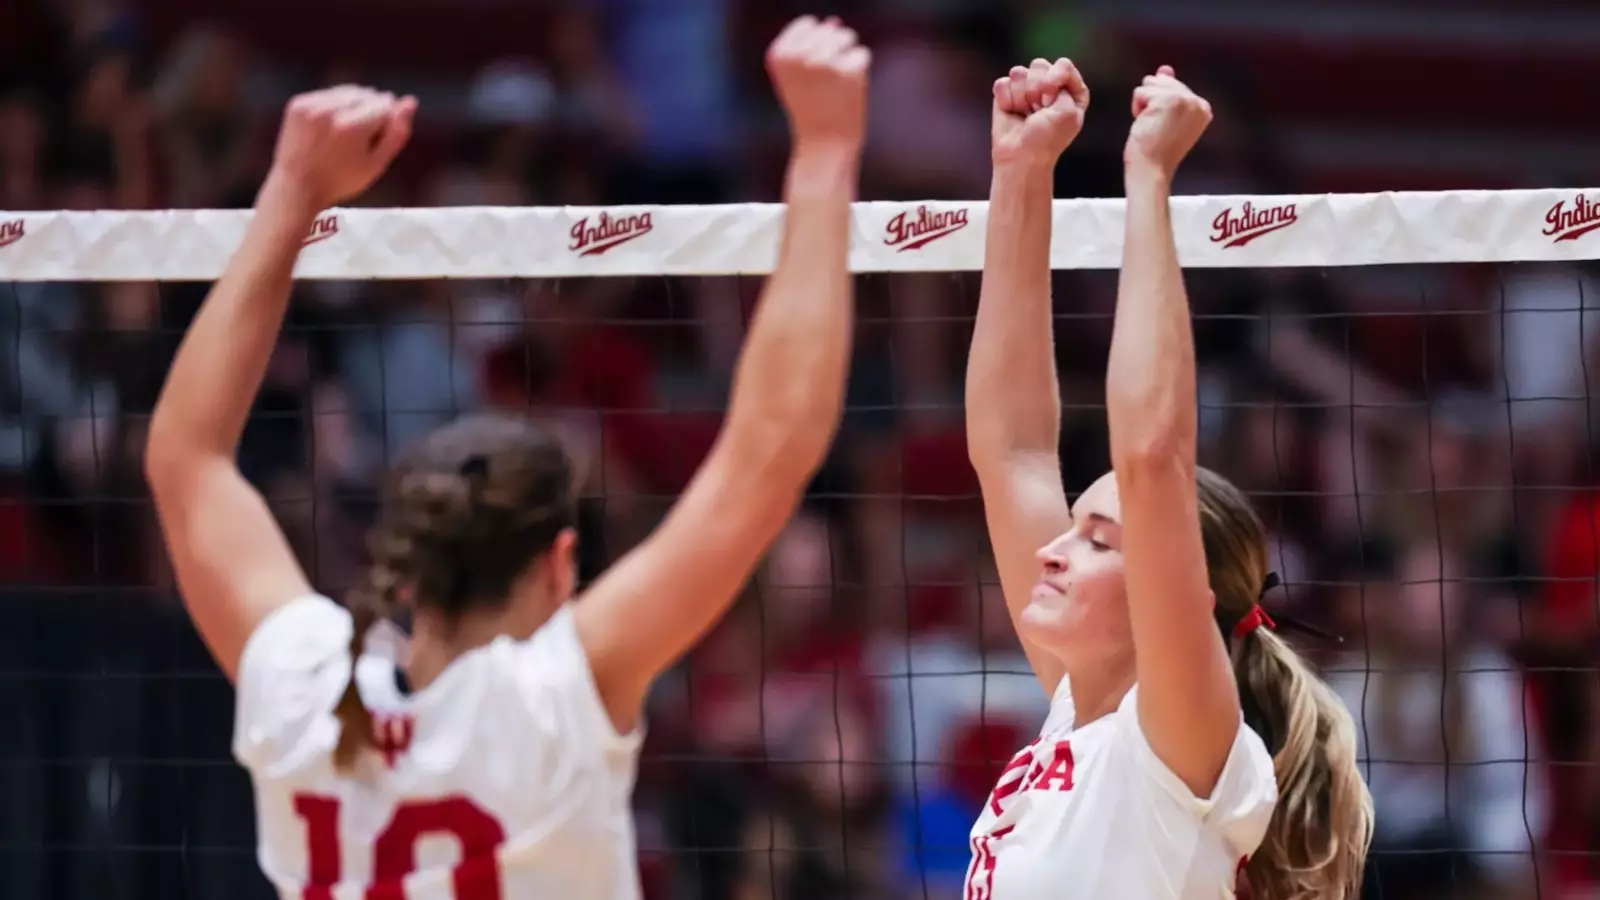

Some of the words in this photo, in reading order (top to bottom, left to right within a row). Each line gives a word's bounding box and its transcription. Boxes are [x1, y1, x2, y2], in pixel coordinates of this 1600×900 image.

[569, 211, 653, 253] Indiana
[884, 206, 969, 248] Indiana
[1210, 201, 1298, 245] Indiana
